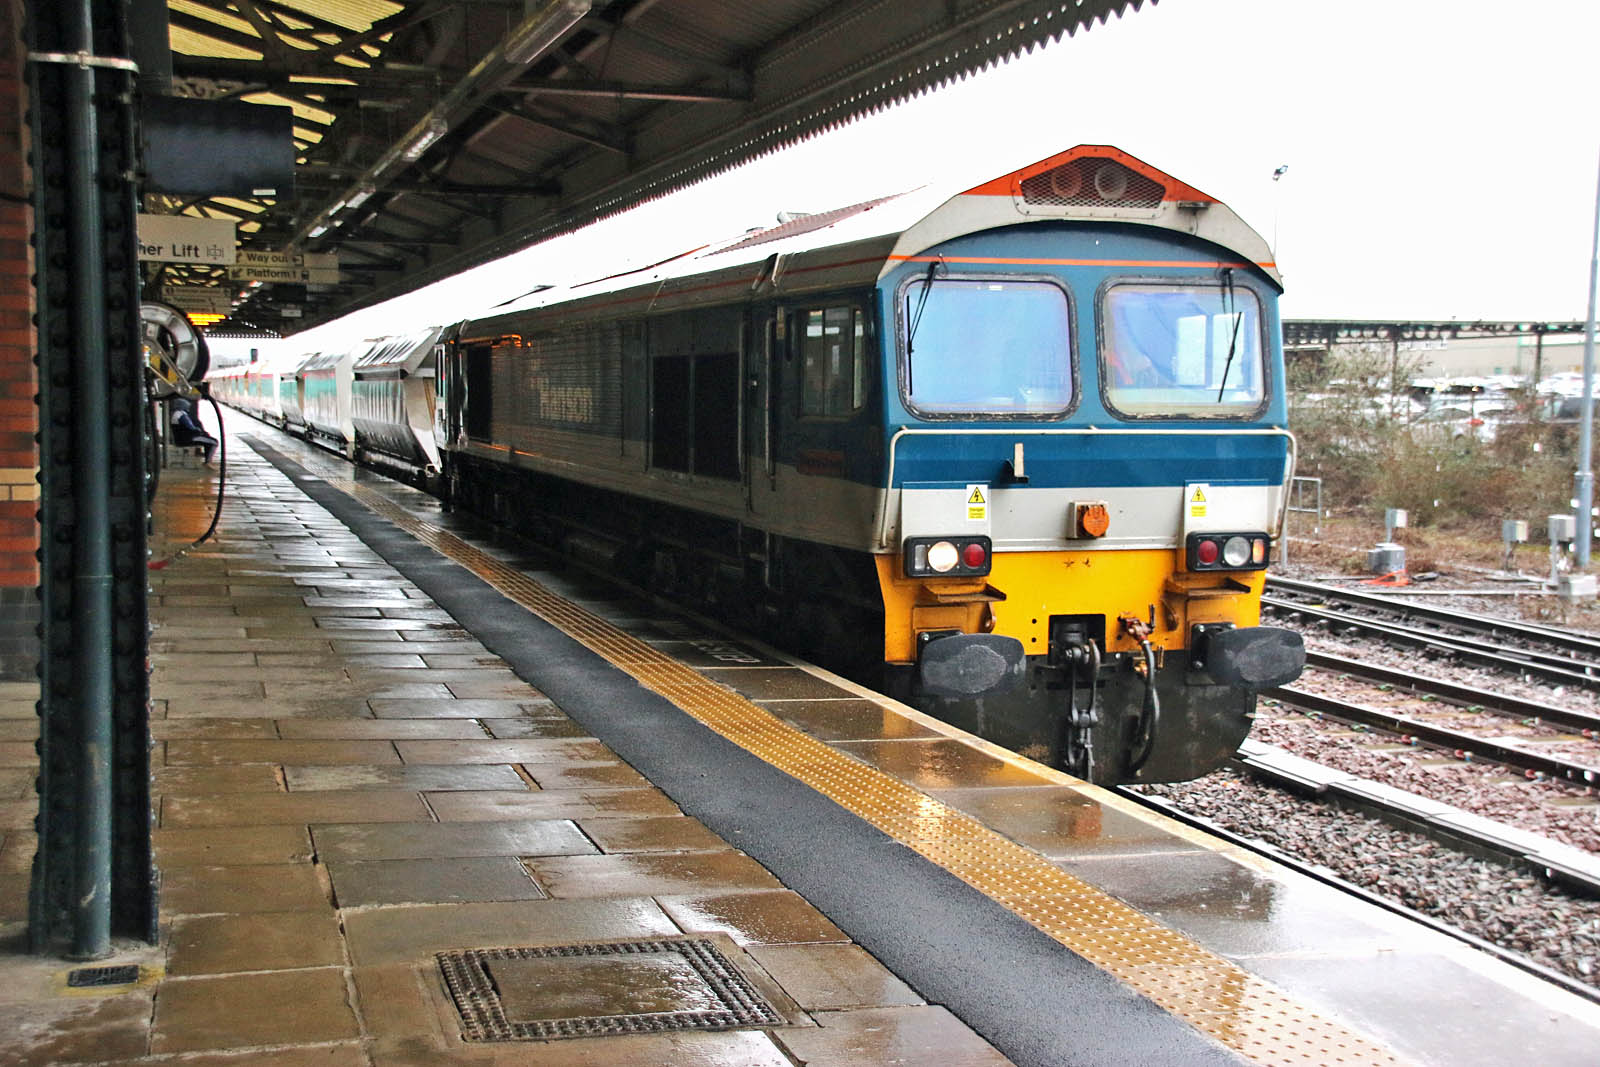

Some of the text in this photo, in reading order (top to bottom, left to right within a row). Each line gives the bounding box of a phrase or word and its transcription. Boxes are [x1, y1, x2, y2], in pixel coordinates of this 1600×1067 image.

[138, 242, 200, 258] her Lift
[246, 252, 270, 264] Way
[247, 268, 290, 278] Platform
